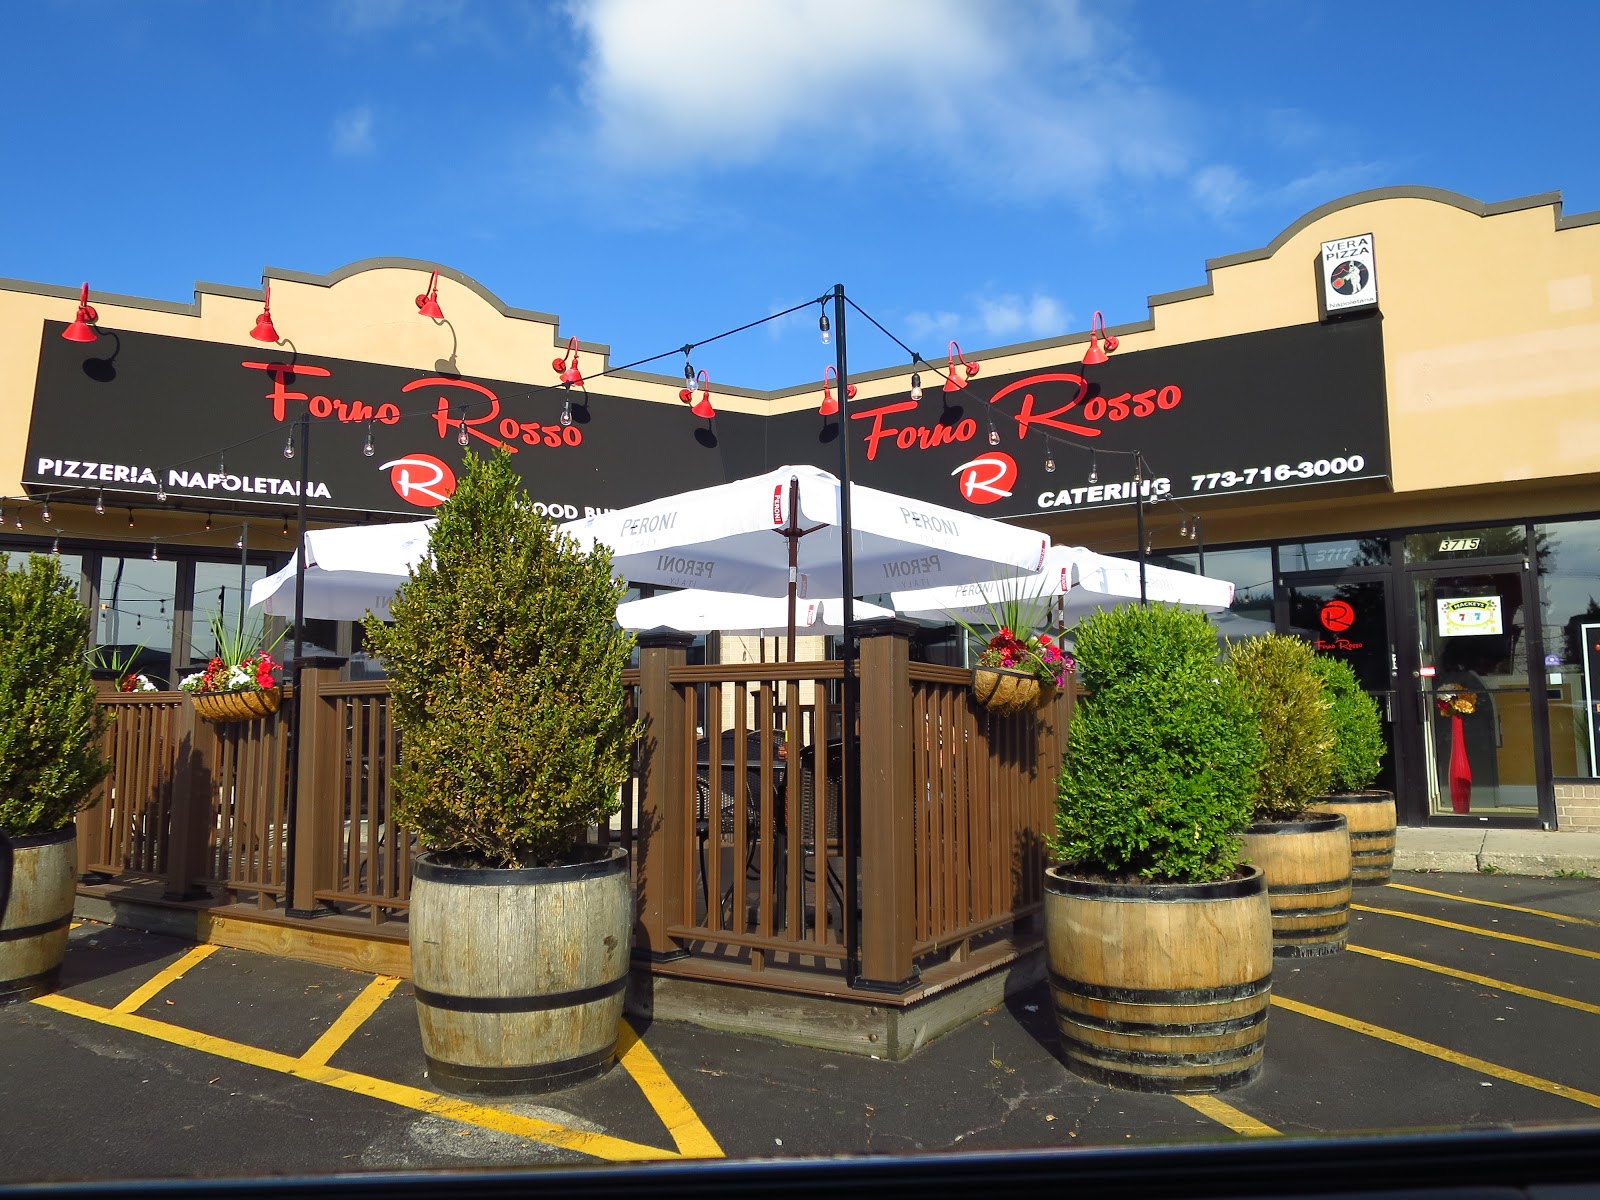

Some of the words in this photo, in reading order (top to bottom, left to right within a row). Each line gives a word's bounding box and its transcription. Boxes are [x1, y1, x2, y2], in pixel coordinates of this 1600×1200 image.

[1326, 238, 1368, 252] VERA
[1326, 247, 1369, 261] PIZZA
[1329, 297, 1374, 308] Napoletana
[241, 361, 401, 425] Forno
[402, 377, 582, 453] Rosso
[851, 401, 977, 461] Forno
[990, 373, 1182, 439] Rosso
[37, 457, 158, 485] PIZZERIA
[168, 469, 332, 499] NAPOLETANA
[1037, 477, 1171, 508] CATERING
[1191, 454, 1365, 491] 773-716-3000
[774, 494, 782, 521] PERONI
[620, 512, 678, 537] PERONI
[899, 506, 959, 537] PERONI
[1315, 547, 1352, 562] 3717
[1442, 539, 1478, 550] 3715
[955, 582, 994, 597] PERONI
